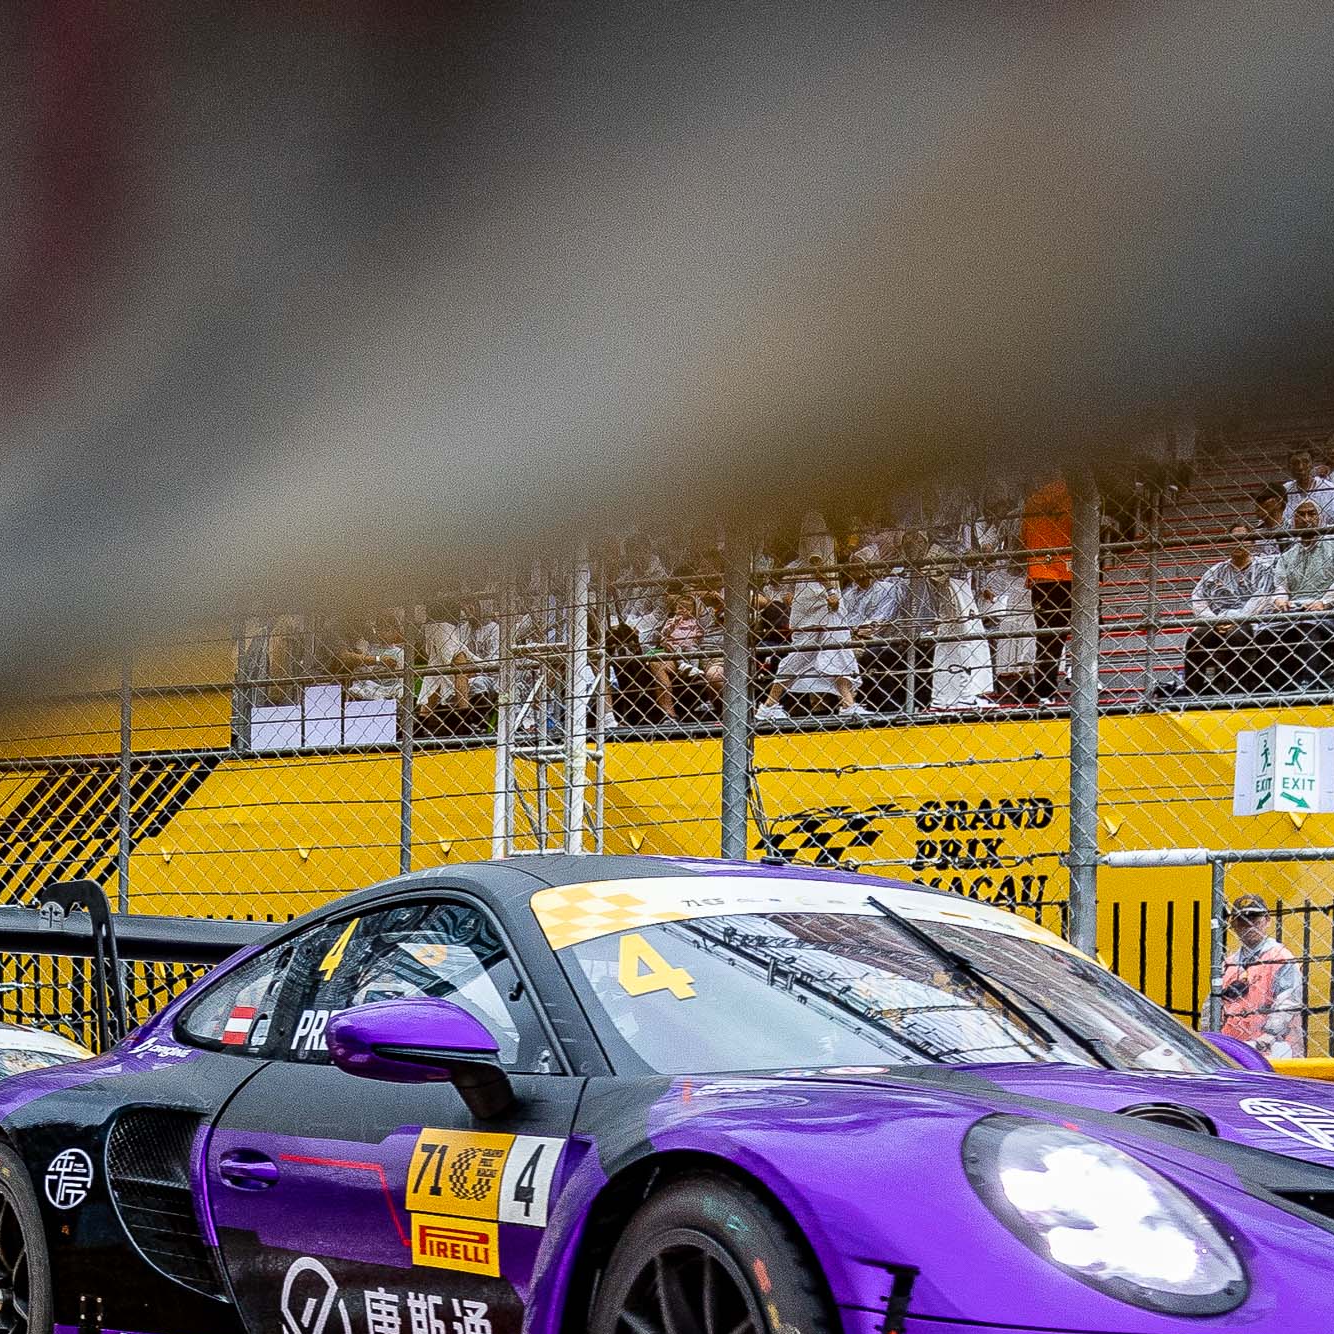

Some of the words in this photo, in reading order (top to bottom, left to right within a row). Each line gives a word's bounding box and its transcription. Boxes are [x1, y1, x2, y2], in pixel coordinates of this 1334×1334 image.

[1256, 778, 1272, 793] EXIT
[1282, 777, 1315, 791] EXIT
[916, 798, 1054, 832] GRAND
[912, 838, 1004, 871] PRIX
[319, 917, 361, 981] 4
[619, 932, 697, 1001] 4
[412, 1143, 449, 1196] 71
[513, 1144, 546, 1217] 4
[419, 1225, 489, 1264] PIRELLI
